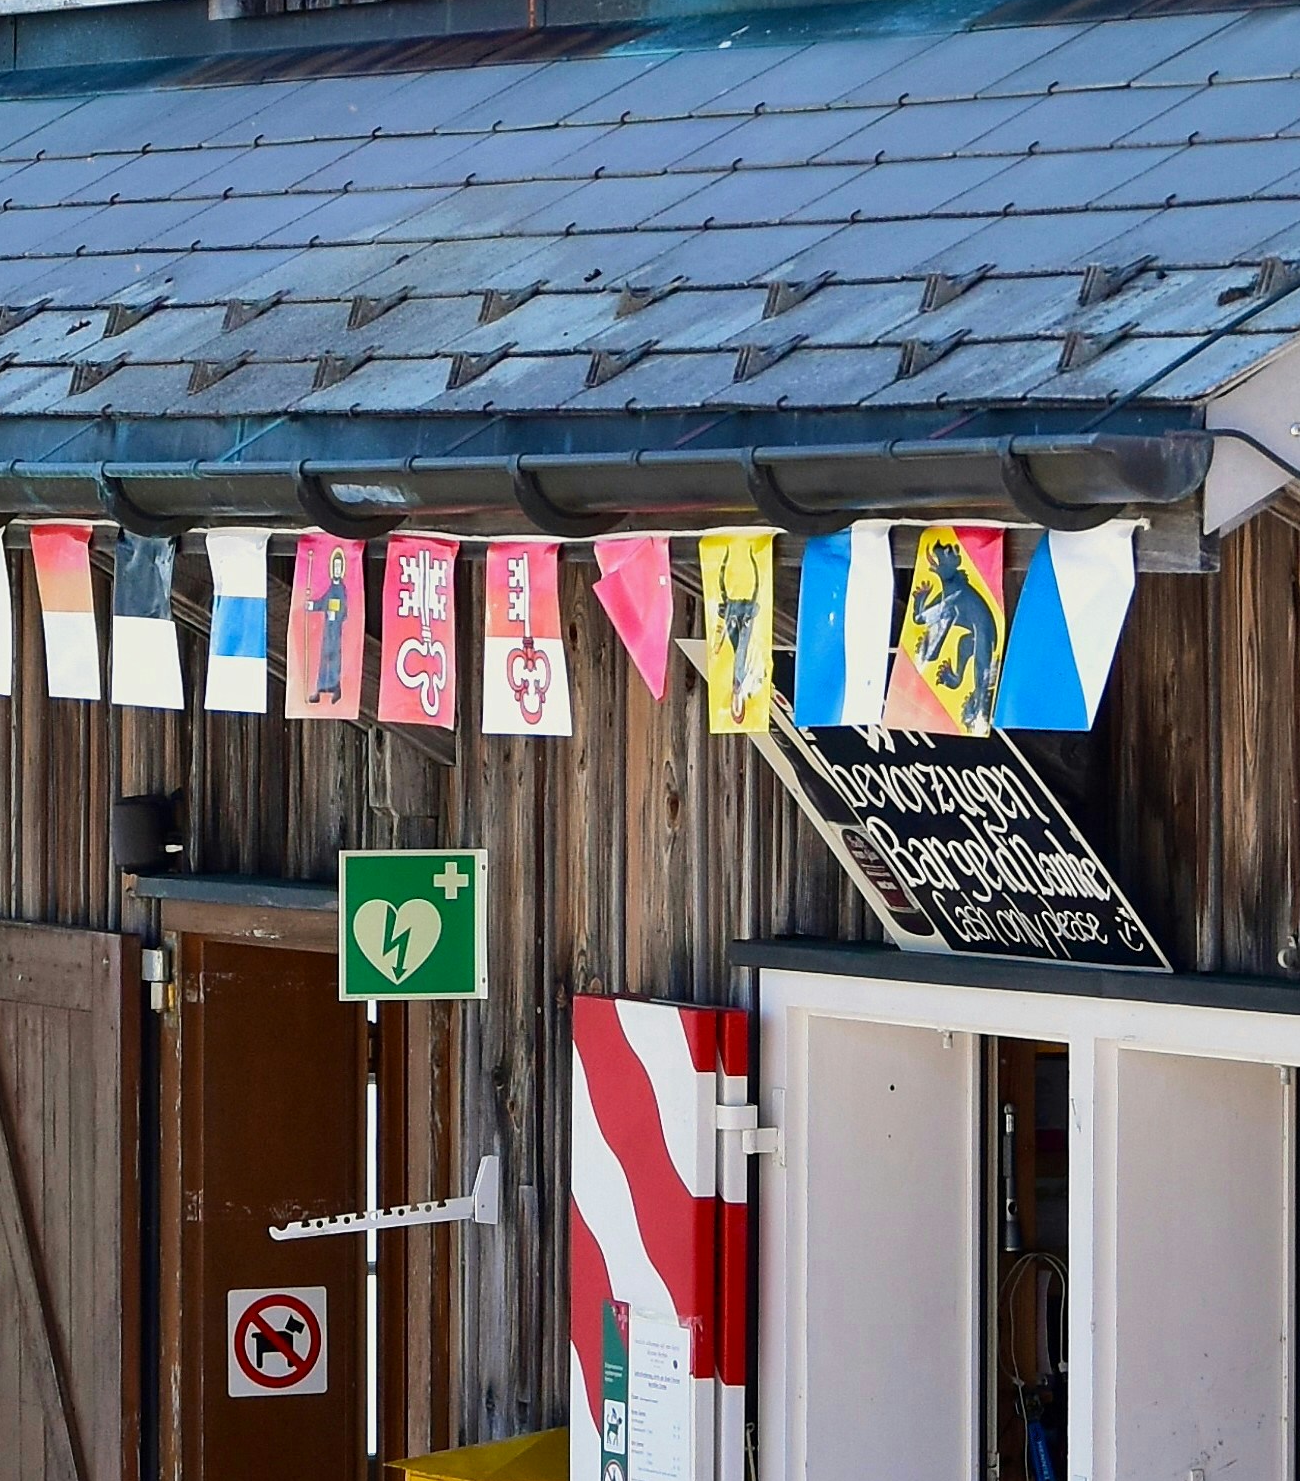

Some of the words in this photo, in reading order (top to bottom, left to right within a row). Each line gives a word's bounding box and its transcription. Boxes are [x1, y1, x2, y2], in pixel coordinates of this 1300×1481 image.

[813, 745, 1050, 829] bevorzugen
[866, 814, 1032, 903] Bargeld
[932, 891, 1010, 946] Cash
[978, 892, 1056, 957] only
[1038, 896, 1108, 957] please
